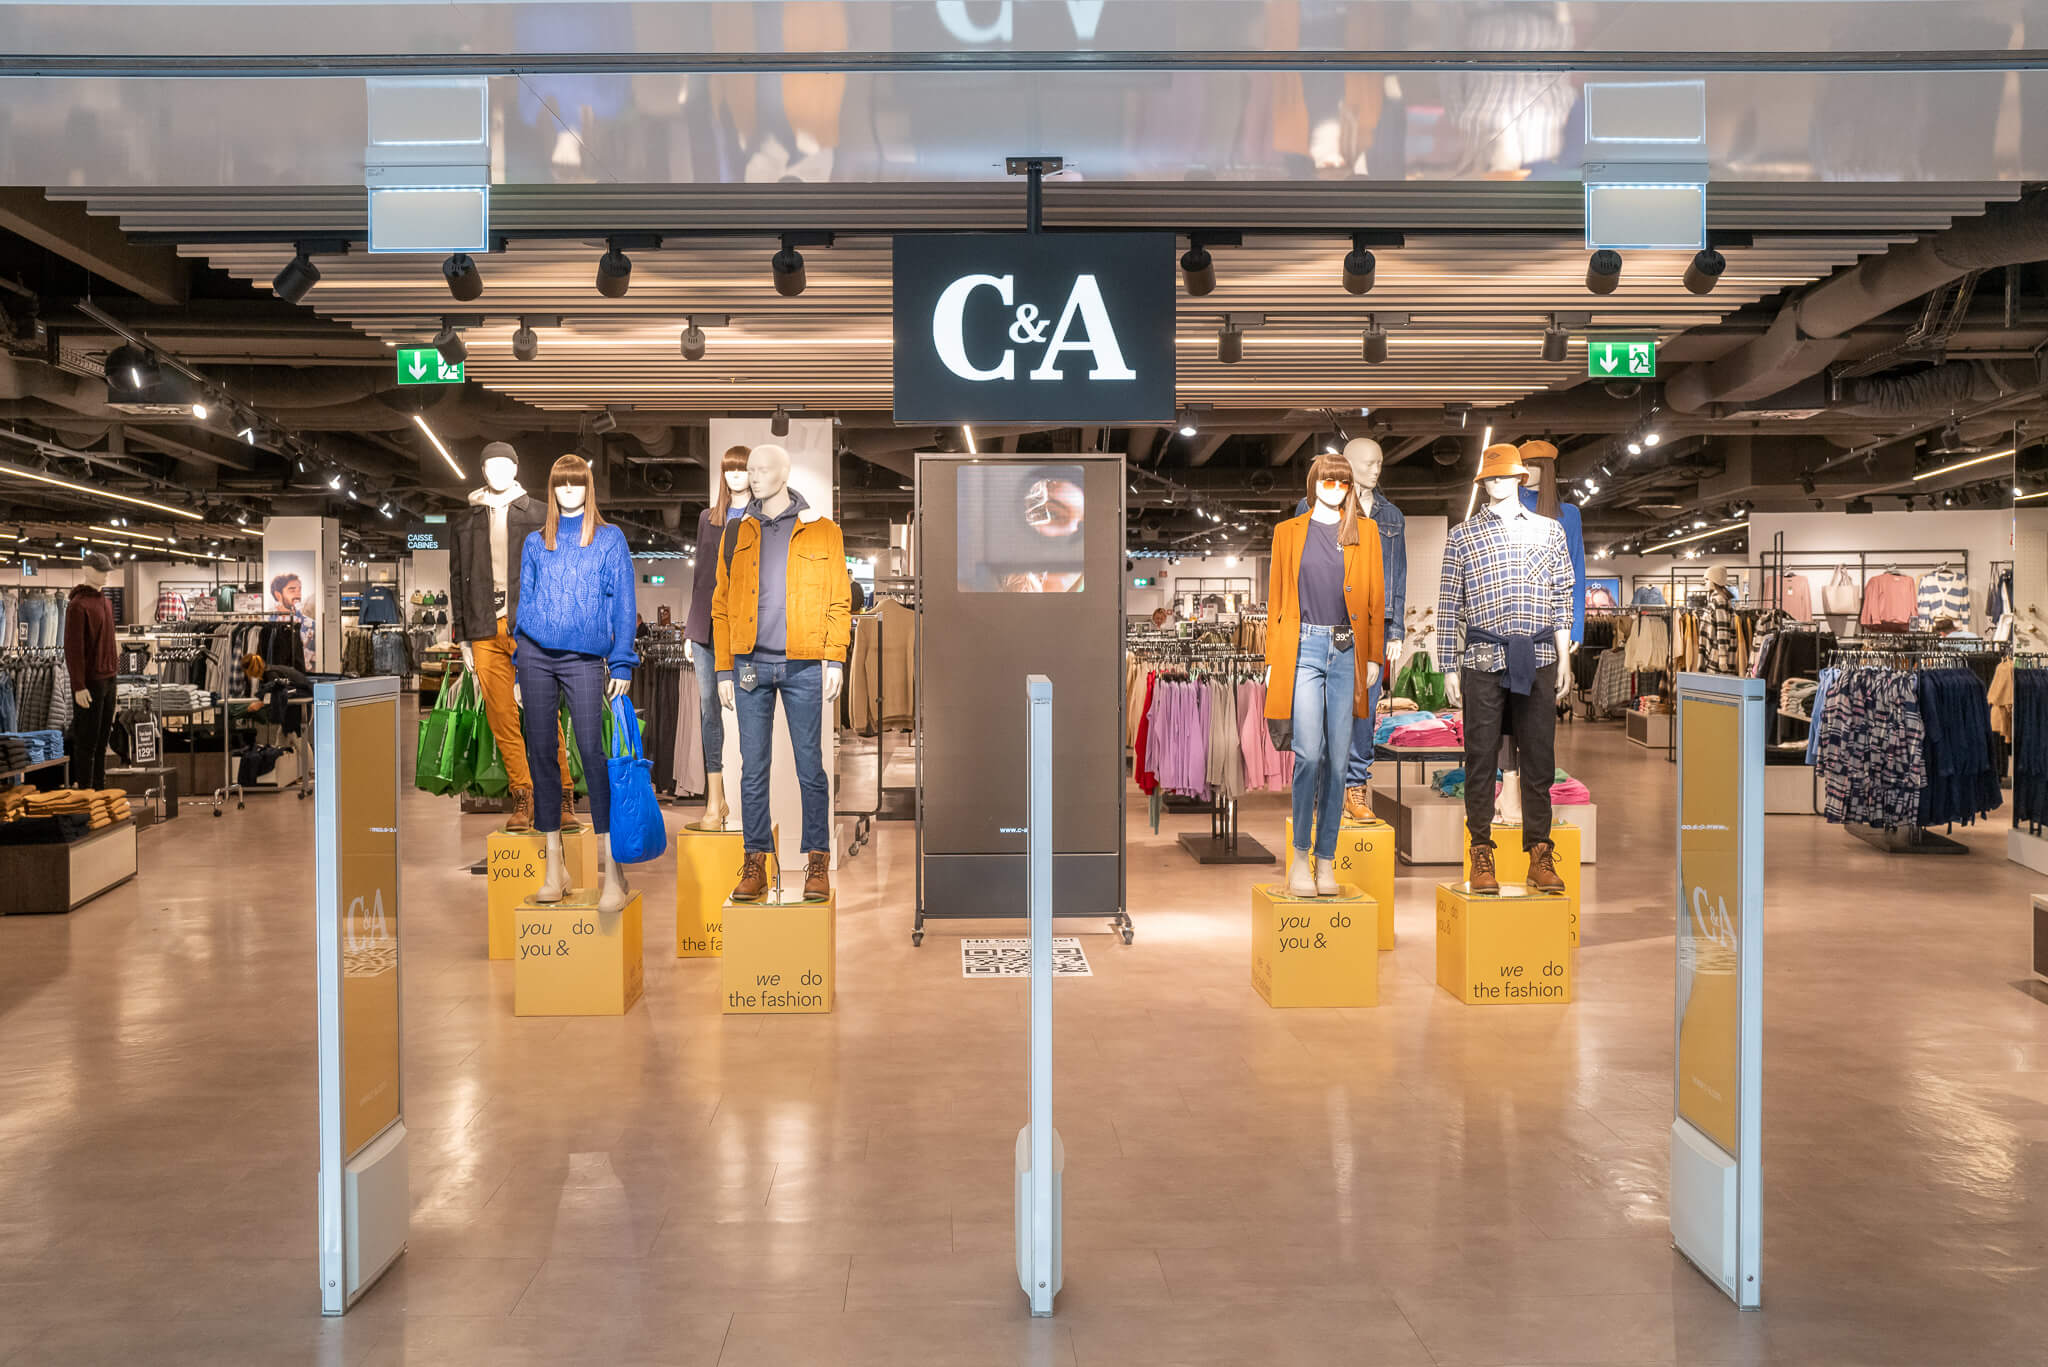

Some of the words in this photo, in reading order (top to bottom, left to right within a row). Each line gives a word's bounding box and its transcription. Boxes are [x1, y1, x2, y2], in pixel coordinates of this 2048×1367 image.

[932, 274, 1137, 381] C&A
[408, 541, 439, 549] CABINES
[1354, 838, 1373, 852] do
[492, 849, 520, 863] you
[1341, 856, 1352, 870] &
[492, 866, 520, 881] you
[523, 863, 536, 878] &
[347, 888, 389, 954] C&A
[706, 922, 723, 933] we
[1278, 916, 1311, 932] you
[1329, 912, 1351, 928] do
[1693, 886, 1738, 953] C&A
[519, 922, 552, 939] you
[572, 918, 594, 935] do
[520, 943, 551, 960] you
[555, 939, 570, 956] &
[682, 937, 706, 951] the
[1279, 937, 1309, 953] you
[1313, 932, 1327, 949] &
[1500, 965, 1523, 977] we
[1542, 960, 1564, 977] do
[756, 974, 781, 986] we
[800, 969, 823, 986] do
[1473, 982, 1500, 998] the
[1505, 981, 1563, 998] fashion
[728, 991, 756, 1007] the
[761, 990, 822, 1007] fashion
